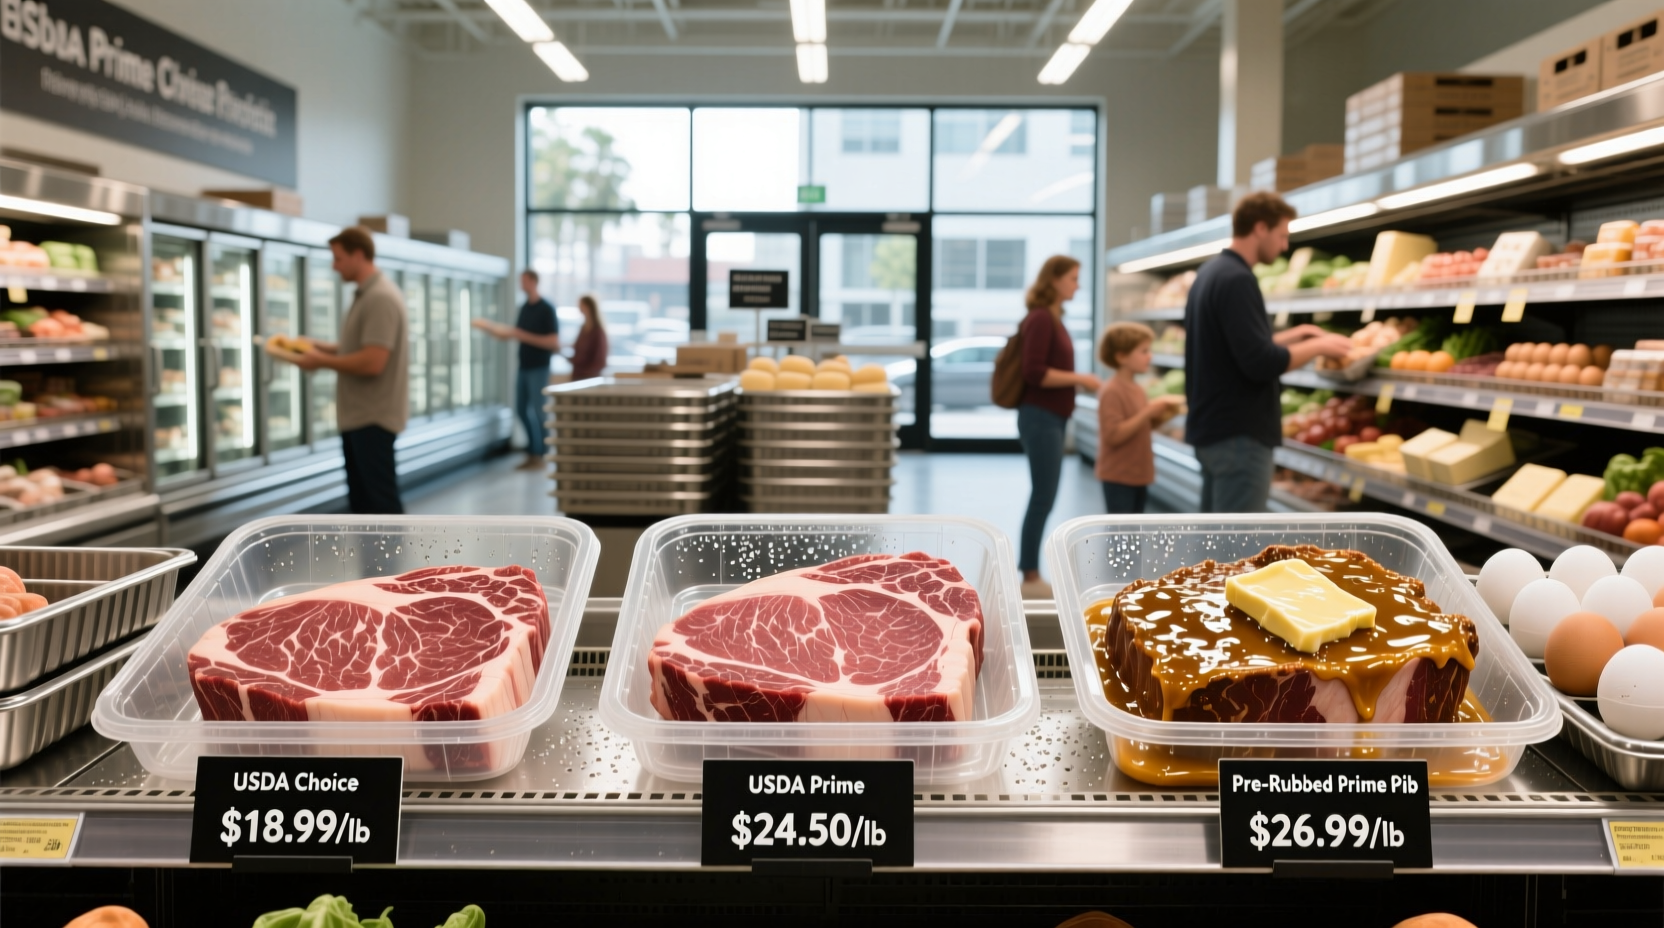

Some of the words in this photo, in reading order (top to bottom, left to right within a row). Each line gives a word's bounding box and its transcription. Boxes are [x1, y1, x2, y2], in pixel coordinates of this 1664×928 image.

[89, 25, 155, 93] Prime
[233, 771, 290, 792] USDA
[294, 772, 360, 792] Choice
[748, 774, 806, 795] USDA
[810, 774, 866, 795] Prime
[1232, 773, 1333, 793] Pre-Rubbed
[1337, 774, 1387, 794] Prime
[1390, 774, 1419, 794] Pib
[219, 806, 371, 848] $18.99/lb
[731, 810, 887, 851] $24.50/lb
[1249, 810, 1405, 852] $26.99/lb
